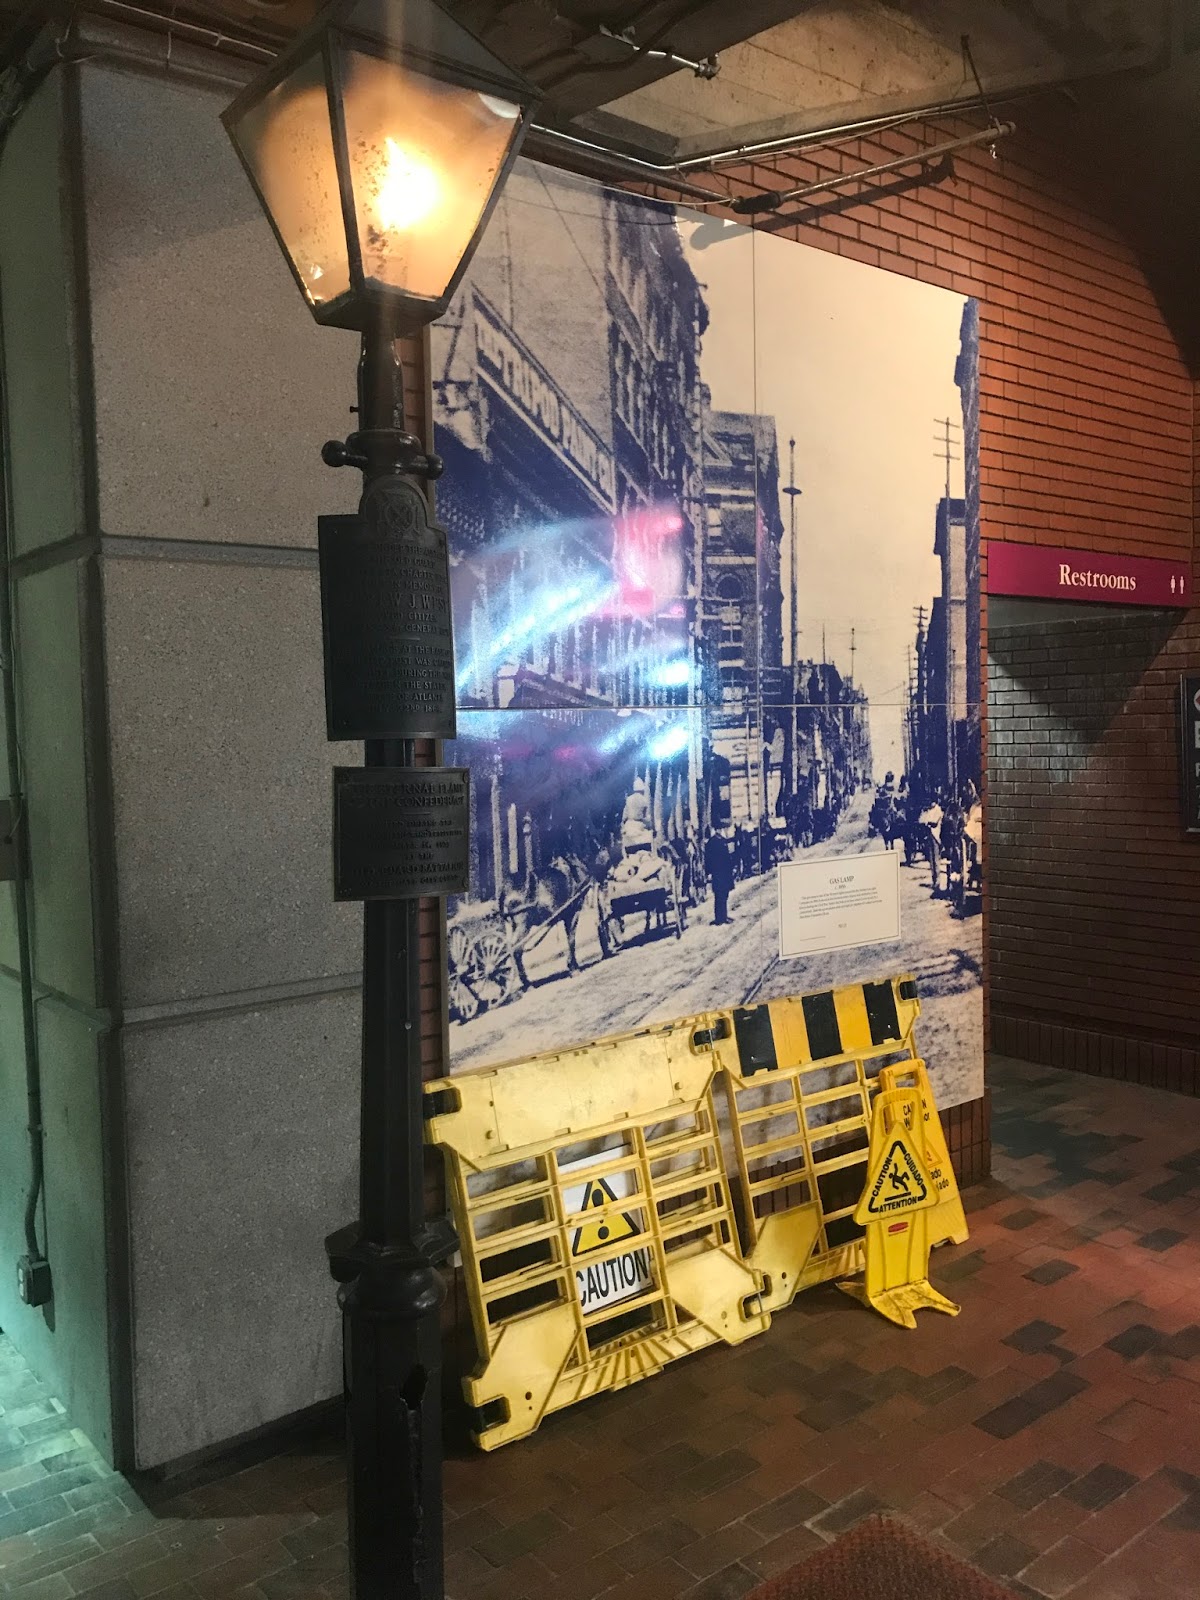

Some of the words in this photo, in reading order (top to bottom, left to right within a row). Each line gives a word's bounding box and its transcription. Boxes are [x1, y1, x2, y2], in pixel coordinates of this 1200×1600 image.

[1059, 563, 1137, 591] Restrooms
[829, 877, 840, 885] GAS
[840, 875, 855, 883] LAMP
[872, 1156, 892, 1197] CAUTION
[904, 1153, 924, 1186] CUIDADO
[878, 1196, 918, 1213] ATTENTION
